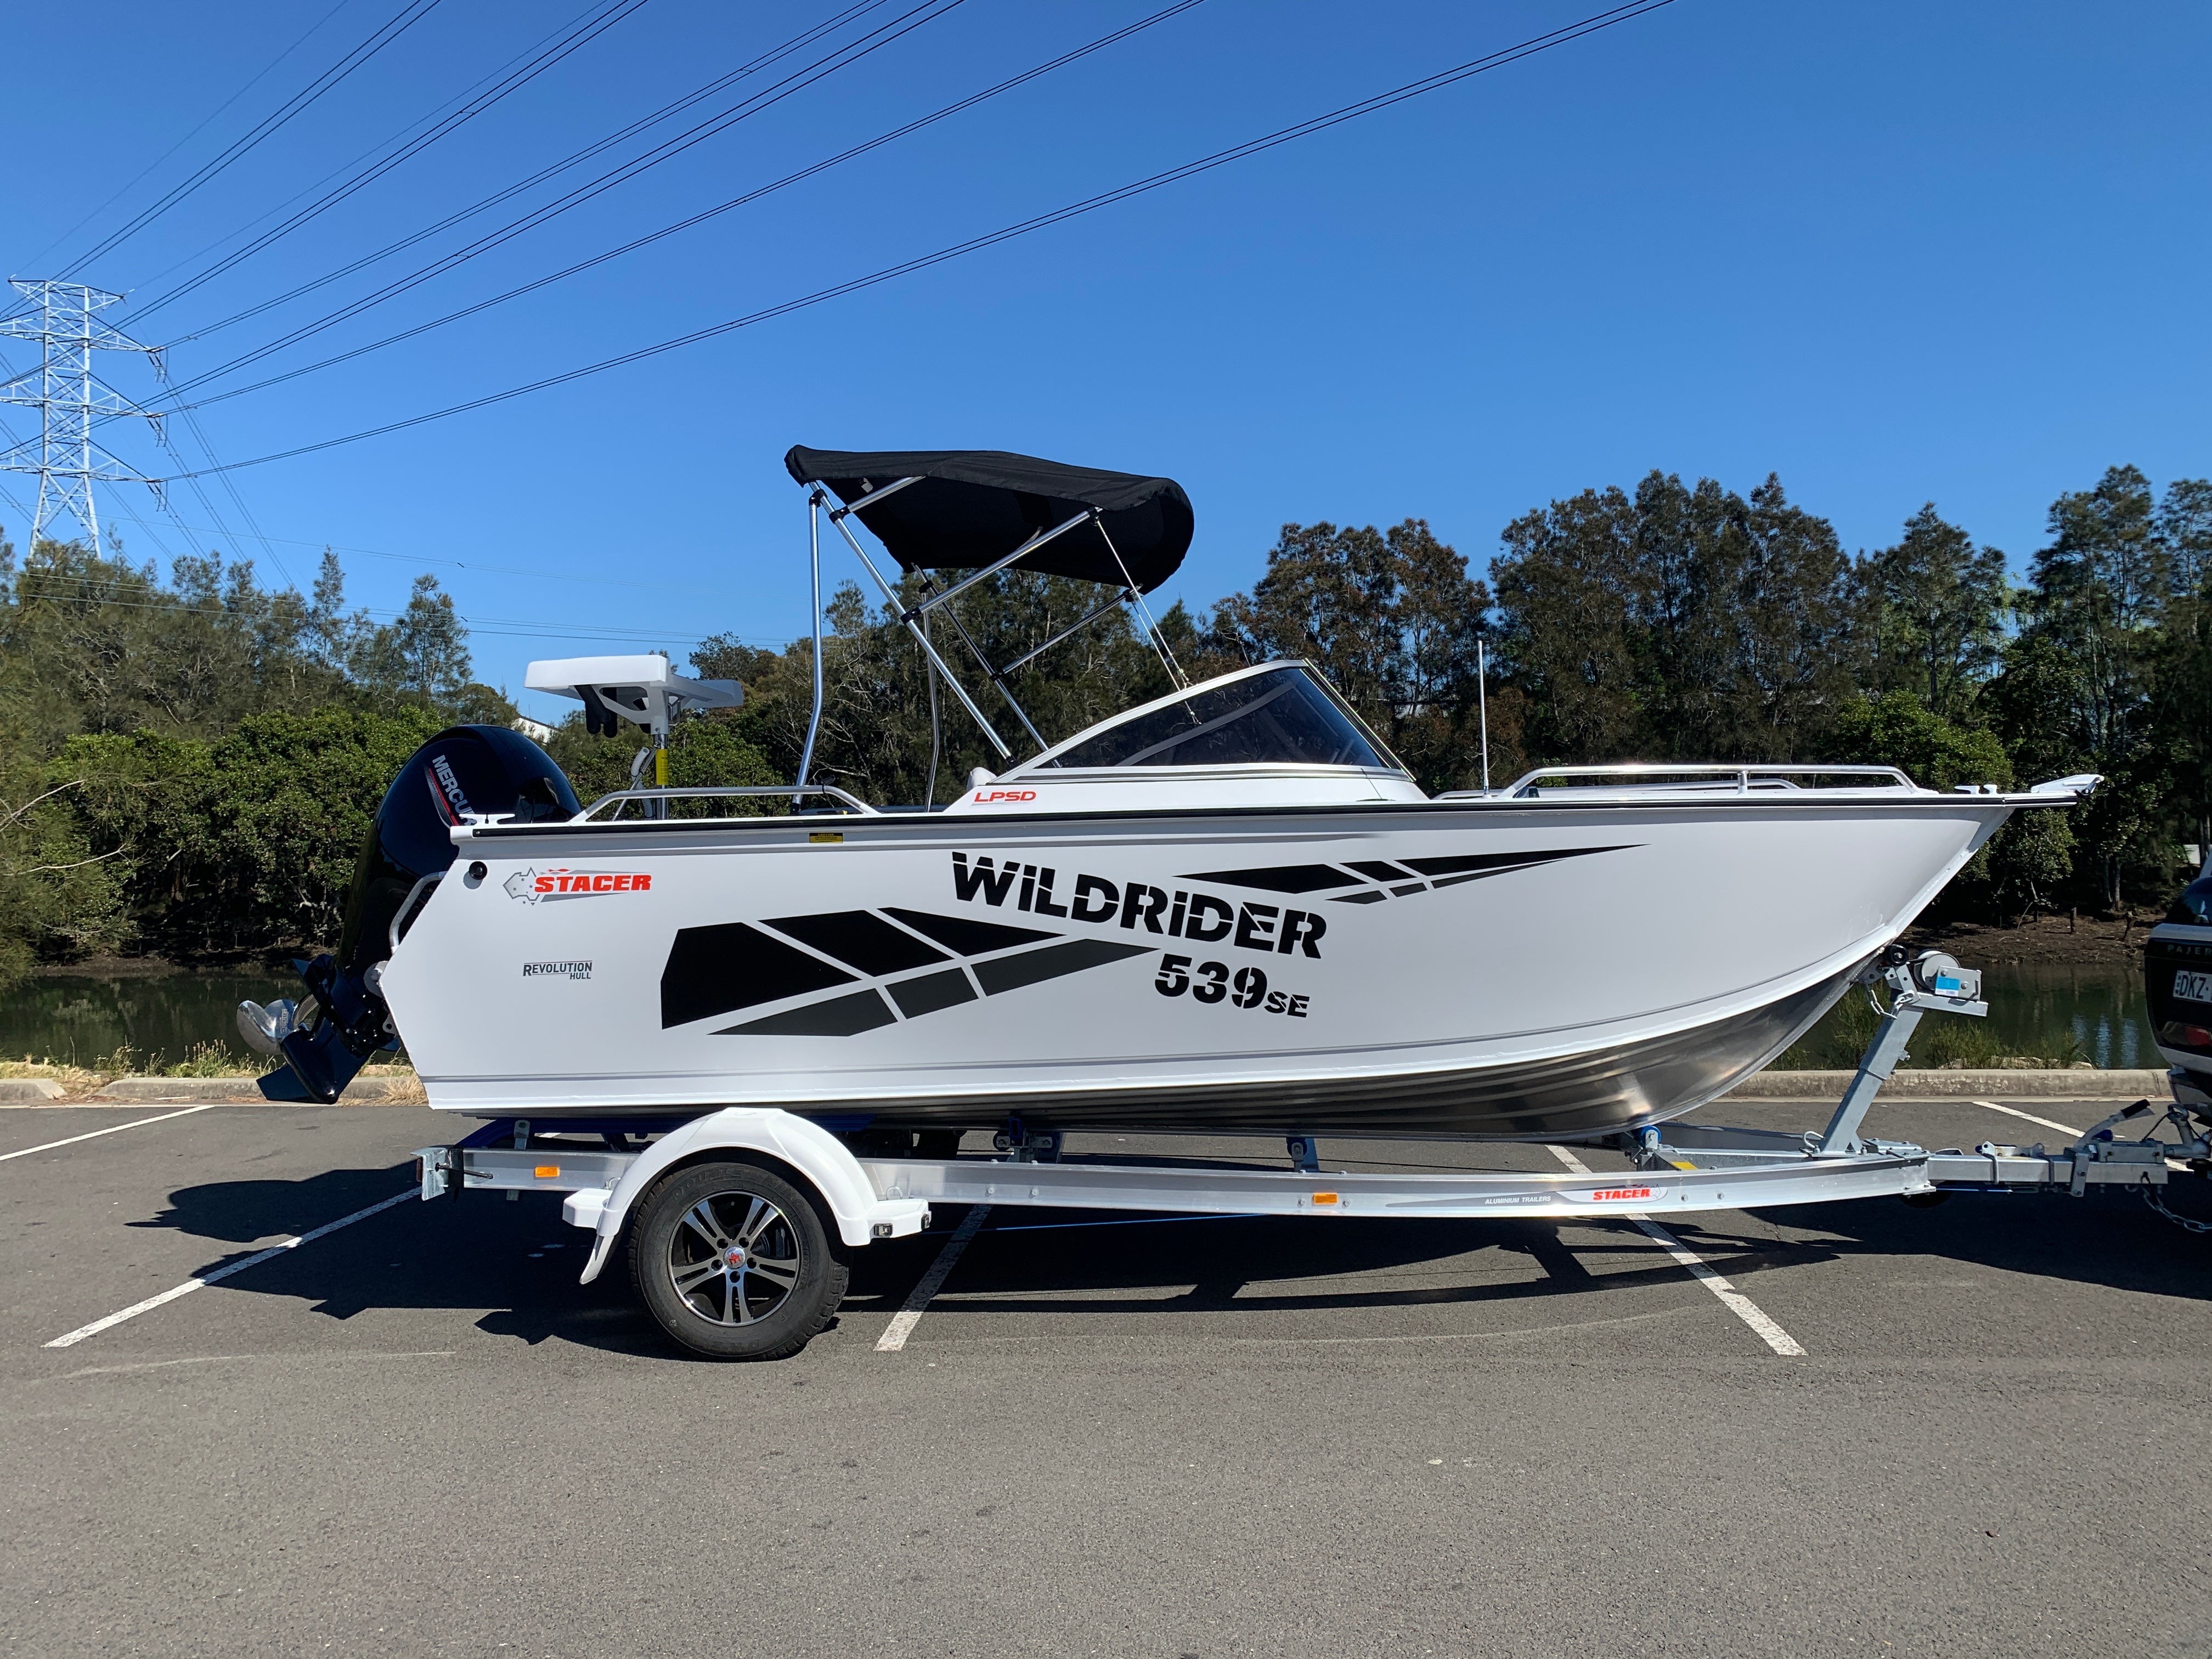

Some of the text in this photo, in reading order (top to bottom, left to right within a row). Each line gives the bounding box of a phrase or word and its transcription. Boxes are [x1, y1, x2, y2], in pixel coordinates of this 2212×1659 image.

[974, 791, 1036, 802] LPSD
[534, 875, 652, 893] STACER
[952, 851, 1327, 960] WILDRIDER
[523, 962, 592, 977] REVOLUTION
[1593, 1188, 1651, 1200] STACER
